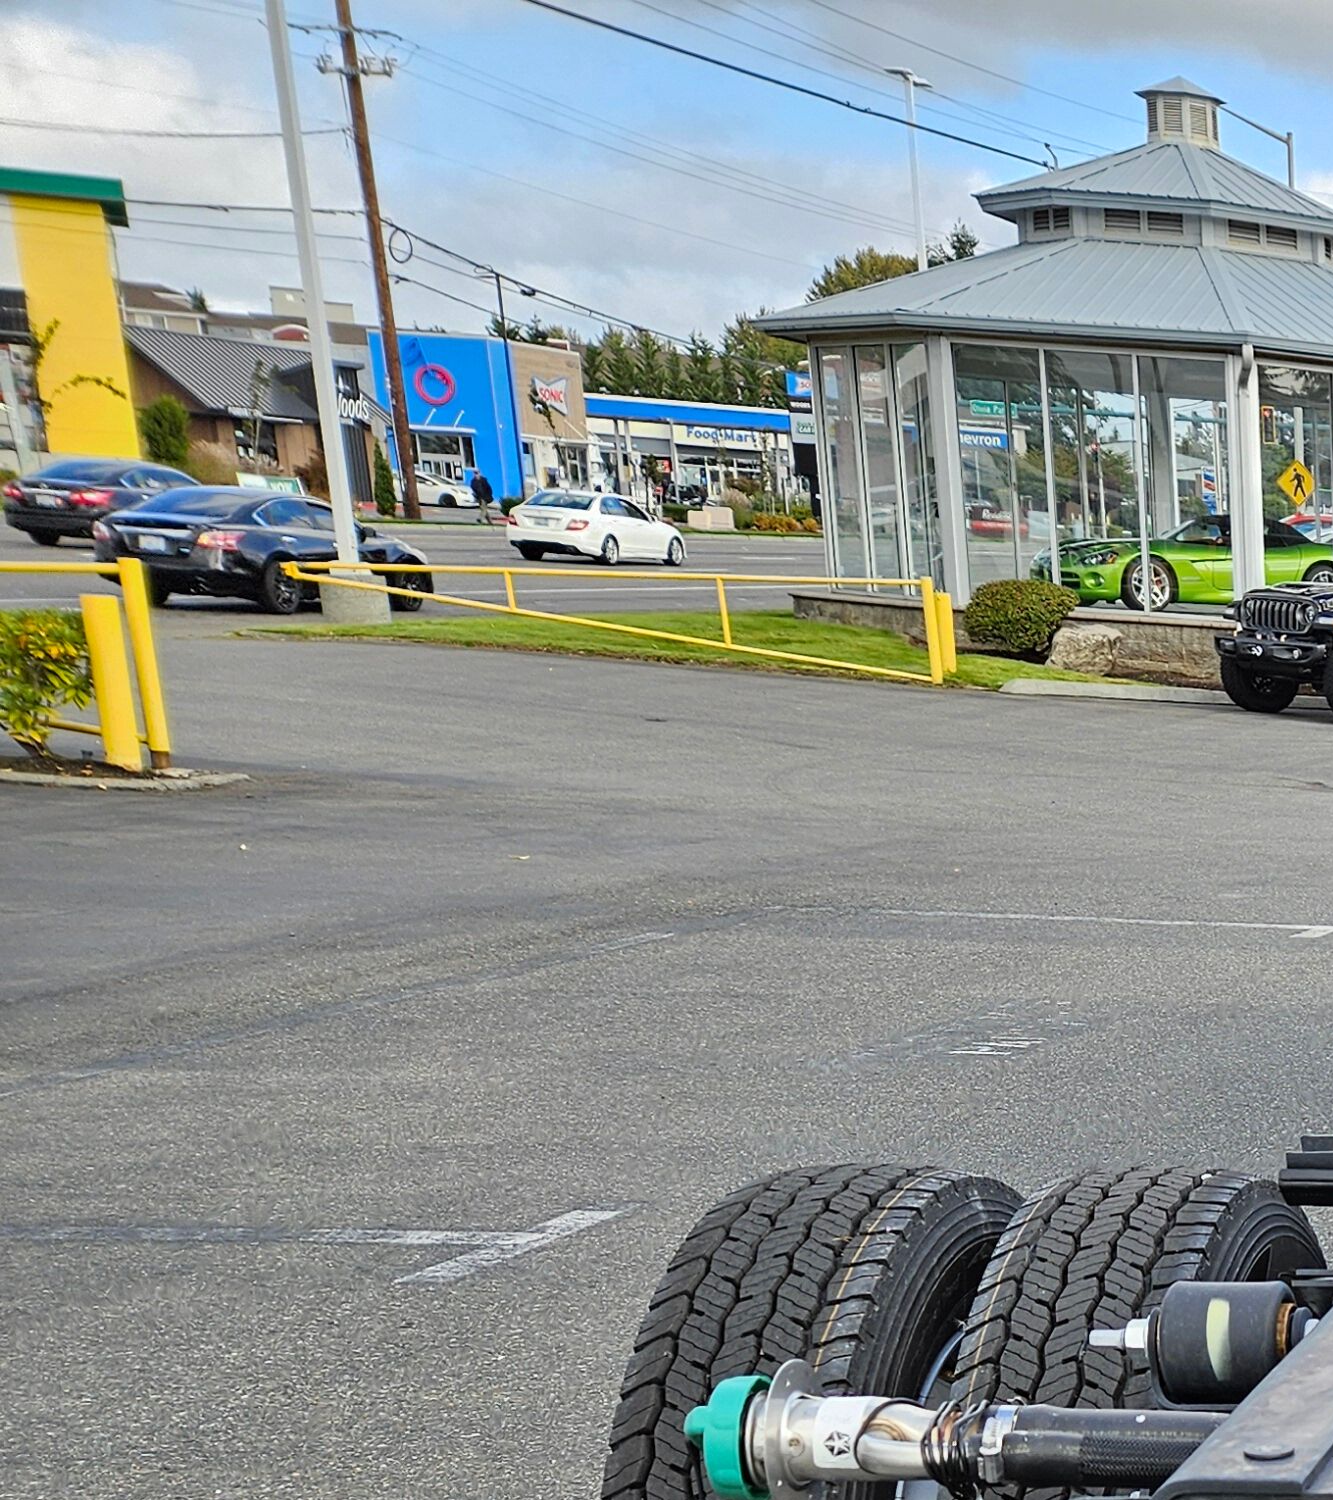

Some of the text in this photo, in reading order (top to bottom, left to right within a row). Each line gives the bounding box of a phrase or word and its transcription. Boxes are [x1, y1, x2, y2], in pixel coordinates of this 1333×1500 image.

[337, 393, 369, 419] oods
[686, 426, 756, 443] Food Mart
[960, 433, 1002, 448] evron
